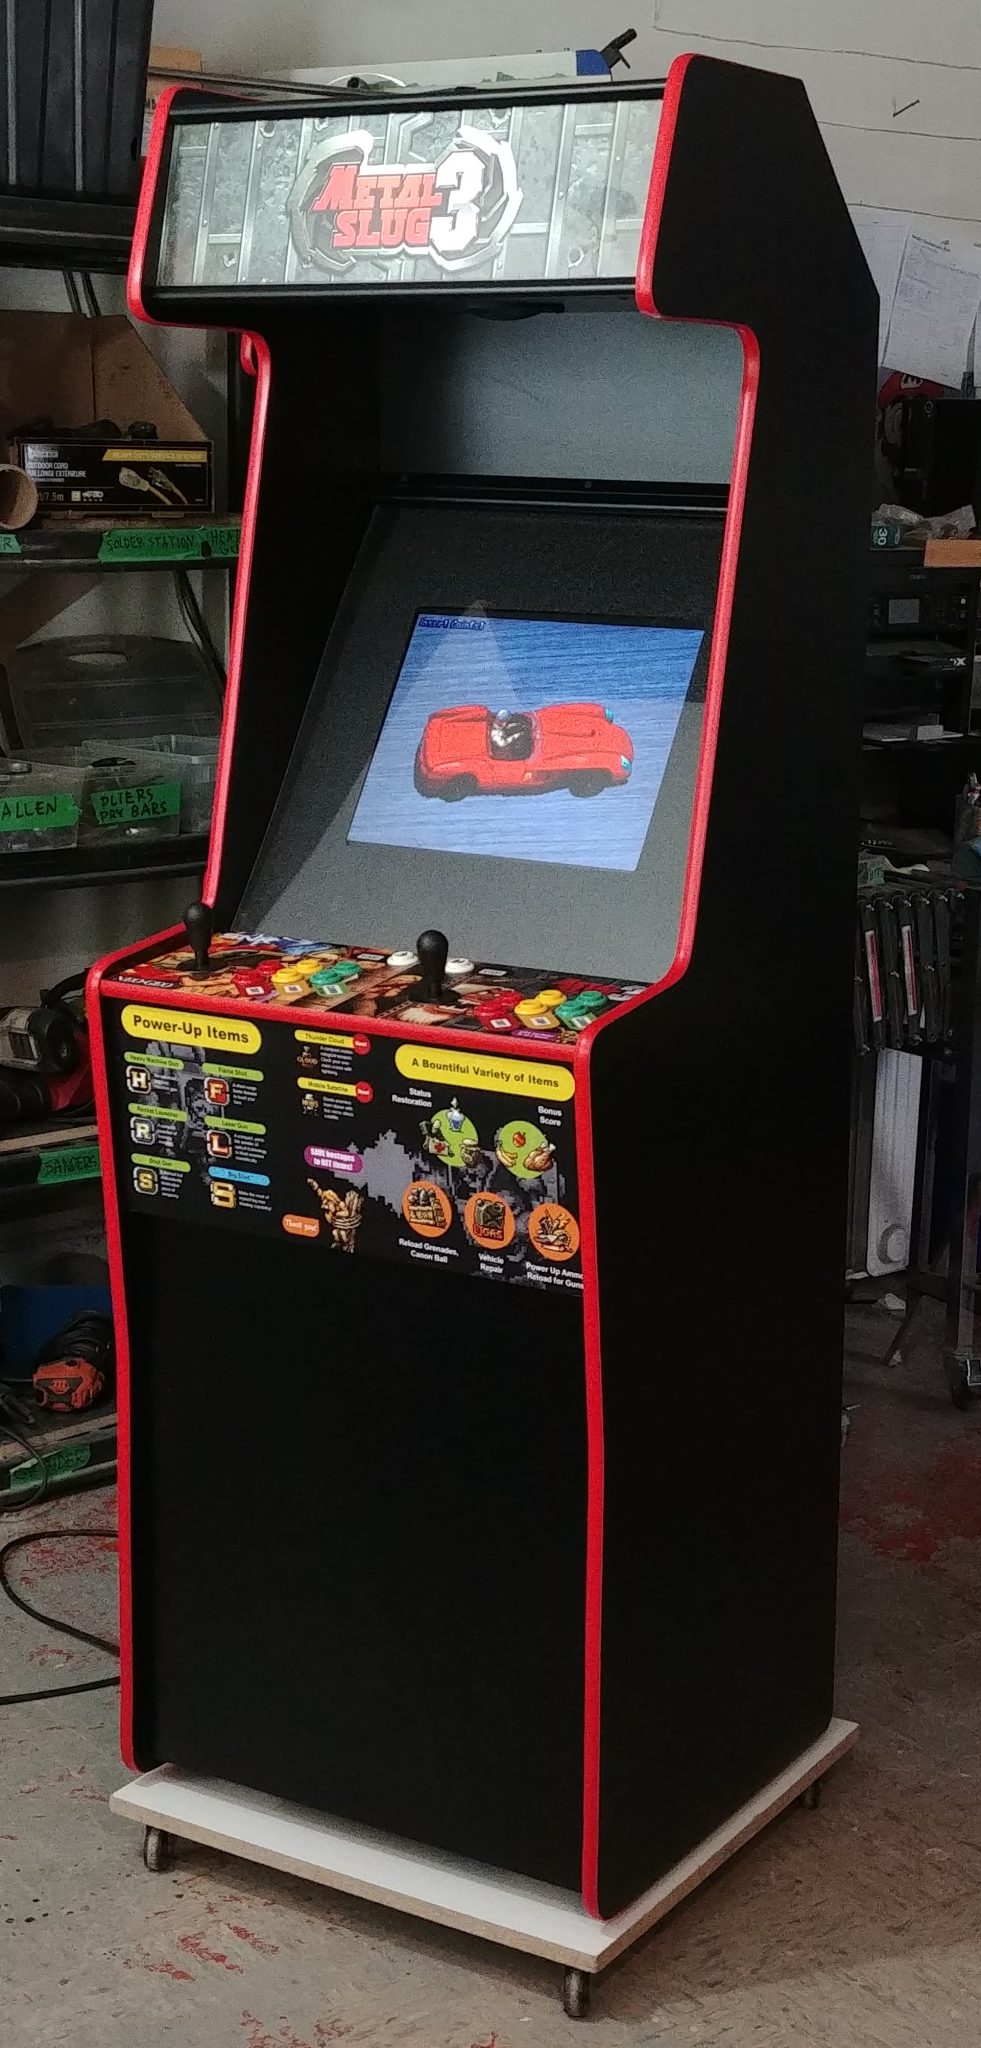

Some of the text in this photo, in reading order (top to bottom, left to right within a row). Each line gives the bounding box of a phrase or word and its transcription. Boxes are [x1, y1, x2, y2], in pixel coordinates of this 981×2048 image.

[312, 162, 442, 211] METAL
[332, 149, 486, 251] SLUG 3
[149, 534, 195, 549] STATION
[101, 788, 154, 810] PLIERS
[1, 797, 58, 820] ALLEN
[131, 799, 168, 818] BARS
[133, 1014, 249, 1043] Power-Up Items
[131, 1071, 148, 1089] H
[411, 1058, 559, 1088] A Bountiful Variety of Items
[209, 1082, 224, 1099] F
[409, 1087, 431, 1098] Status
[392, 1094, 432, 1108] Restoration
[537, 1105, 562, 1117] Bonus
[539, 1116, 561, 1127] Score
[135, 1122, 150, 1139] R
[211, 1134, 228, 1152] L
[138, 1173, 153, 1189] S
[398, 1237, 459, 1256] Reload Grenades,
[410, 1250, 448, 1264] Canon Ball
[478, 1252, 504, 1265] Vehicle
[480, 1263, 504, 1274] Repair
[525, 1261, 549, 1273] Power
[549, 1266, 560, 1277] Up
[527, 1271, 552, 1284] Reload
[553, 1276, 564, 1286] for
